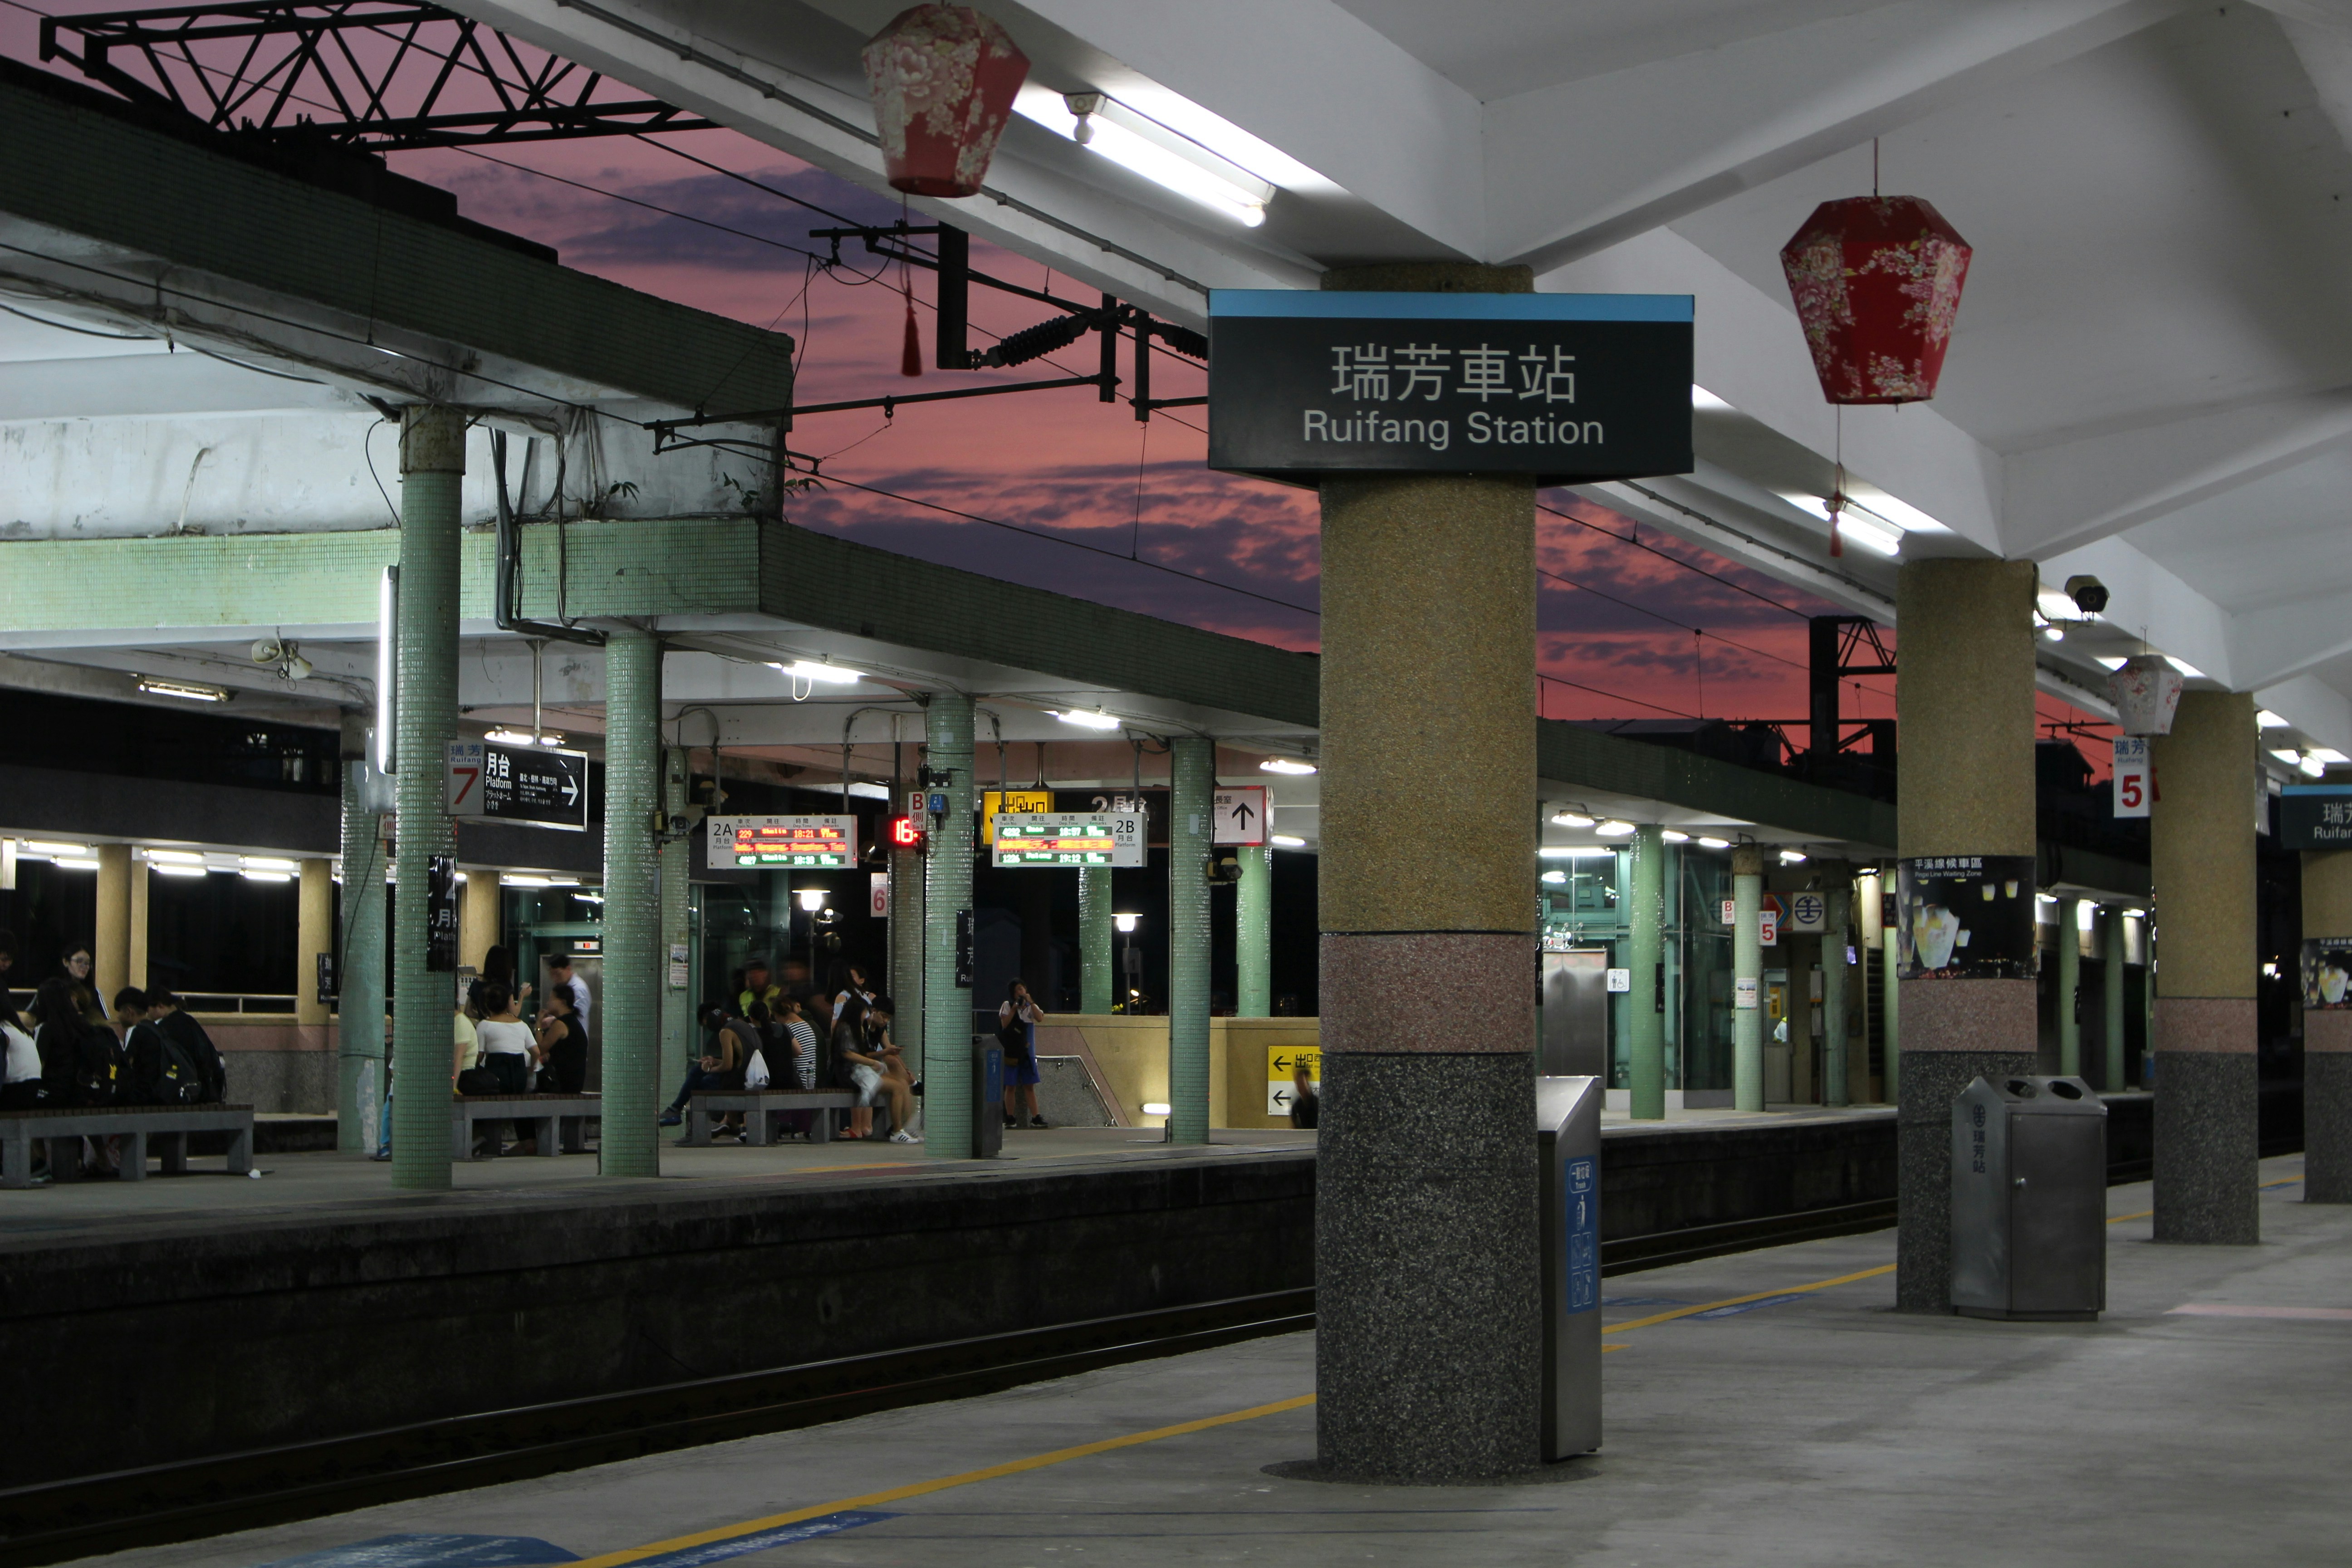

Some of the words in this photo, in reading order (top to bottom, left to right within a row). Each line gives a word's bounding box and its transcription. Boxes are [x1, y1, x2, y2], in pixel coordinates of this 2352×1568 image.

[1331, 343, 1576, 403] 瑞芳車站
[1304, 410, 1450, 451] Ruifang
[1467, 412, 1603, 444] Station
[451, 745, 481, 756] 瑞芳
[2115, 739, 2145, 755] 瑞芳
[486, 752, 510, 778] 月台
[453, 768, 479, 804] 7
[486, 776, 512, 789] Platform
[2122, 774, 2142, 808] 5
[912, 793, 923, 810] B
[912, 812, 923, 823] 側
[713, 823, 733, 836] 2A
[739, 829, 753, 838] 229
[794, 829, 814, 838] 18:21
[1116, 820, 1134, 833] 2B
[1059, 853, 1081, 863] 19:12
[1915, 857, 1982, 870] 平溪線候車區
[873, 889, 885, 911] 6
[1725, 902, 1732, 911] B
[1762, 924, 1774, 941] 5
[1295, 1053, 1313, 1068] 出口
[1973, 1130, 1986, 1174] 瑞芳站
